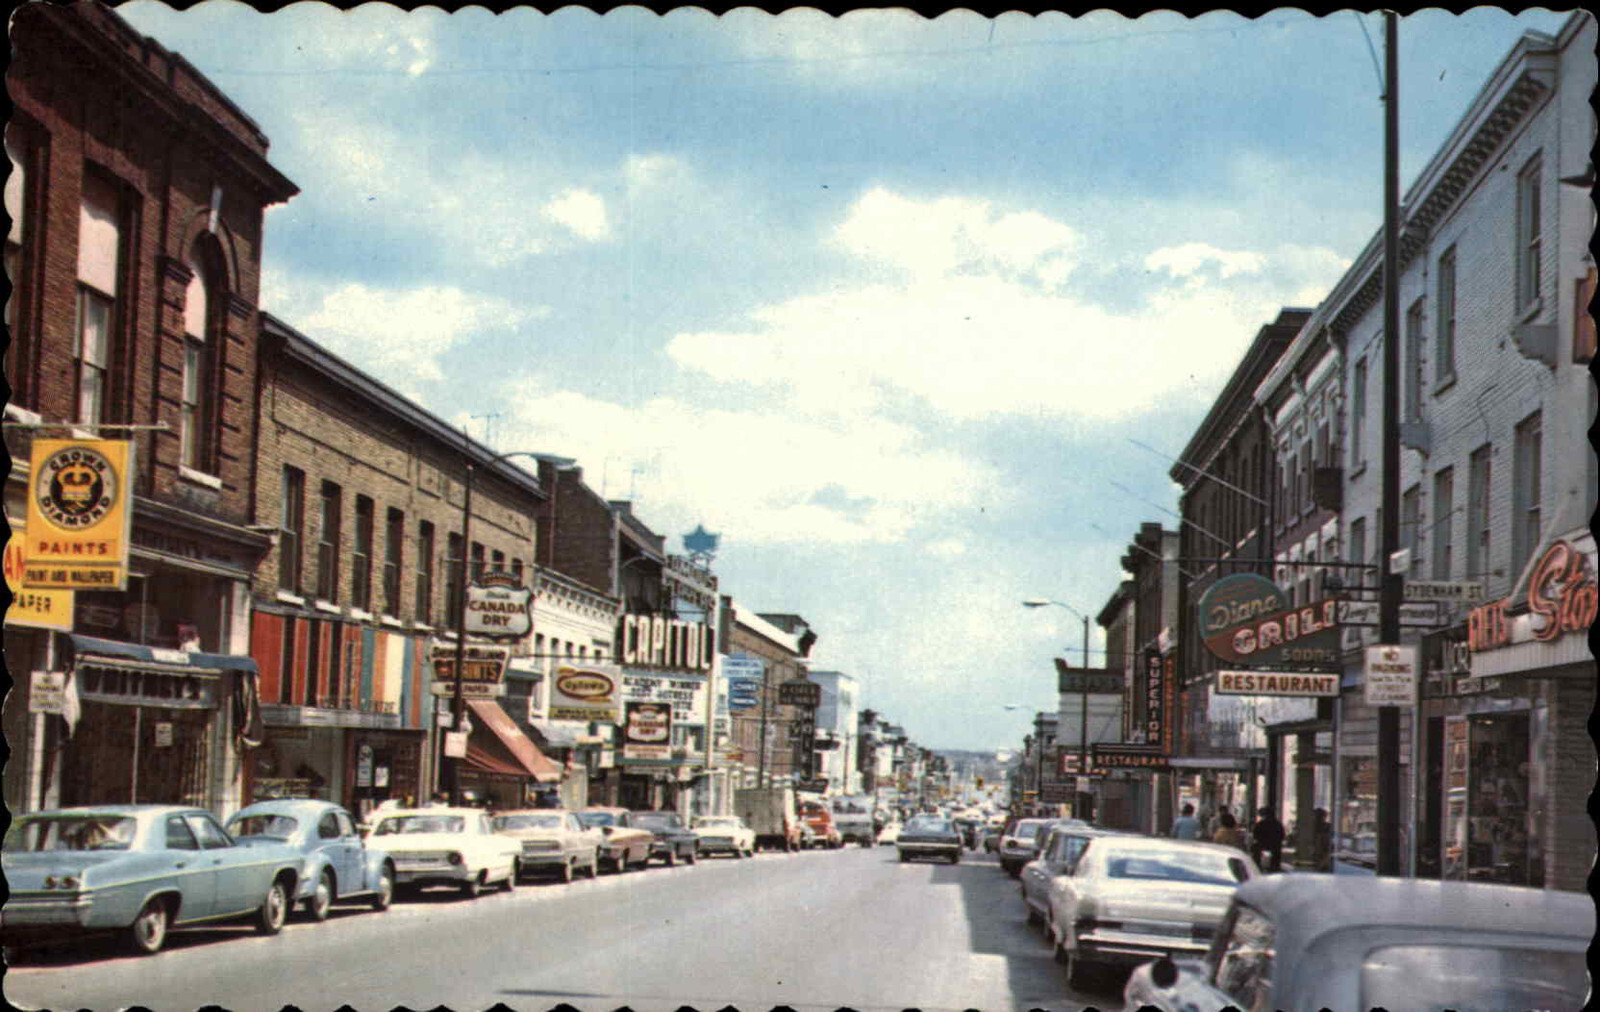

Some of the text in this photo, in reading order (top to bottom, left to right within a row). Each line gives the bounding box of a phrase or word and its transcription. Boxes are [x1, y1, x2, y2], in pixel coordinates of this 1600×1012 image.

[49, 451, 106, 472] CROWN
[41, 495, 110, 525] DIAMOND
[39, 541, 107, 555] PAINTS
[1405, 584, 1462, 598] SYDENHAM
[468, 600, 525, 614] CANADA
[1206, 595, 1279, 630] Diana
[482, 614, 510, 627] DRY
[624, 613, 710, 669] CAPITOL
[1222, 674, 1334, 692] RESTAURANT
[1149, 656, 1160, 741] SUPERIOR
[1096, 755, 1166, 766] RESTAURAN
